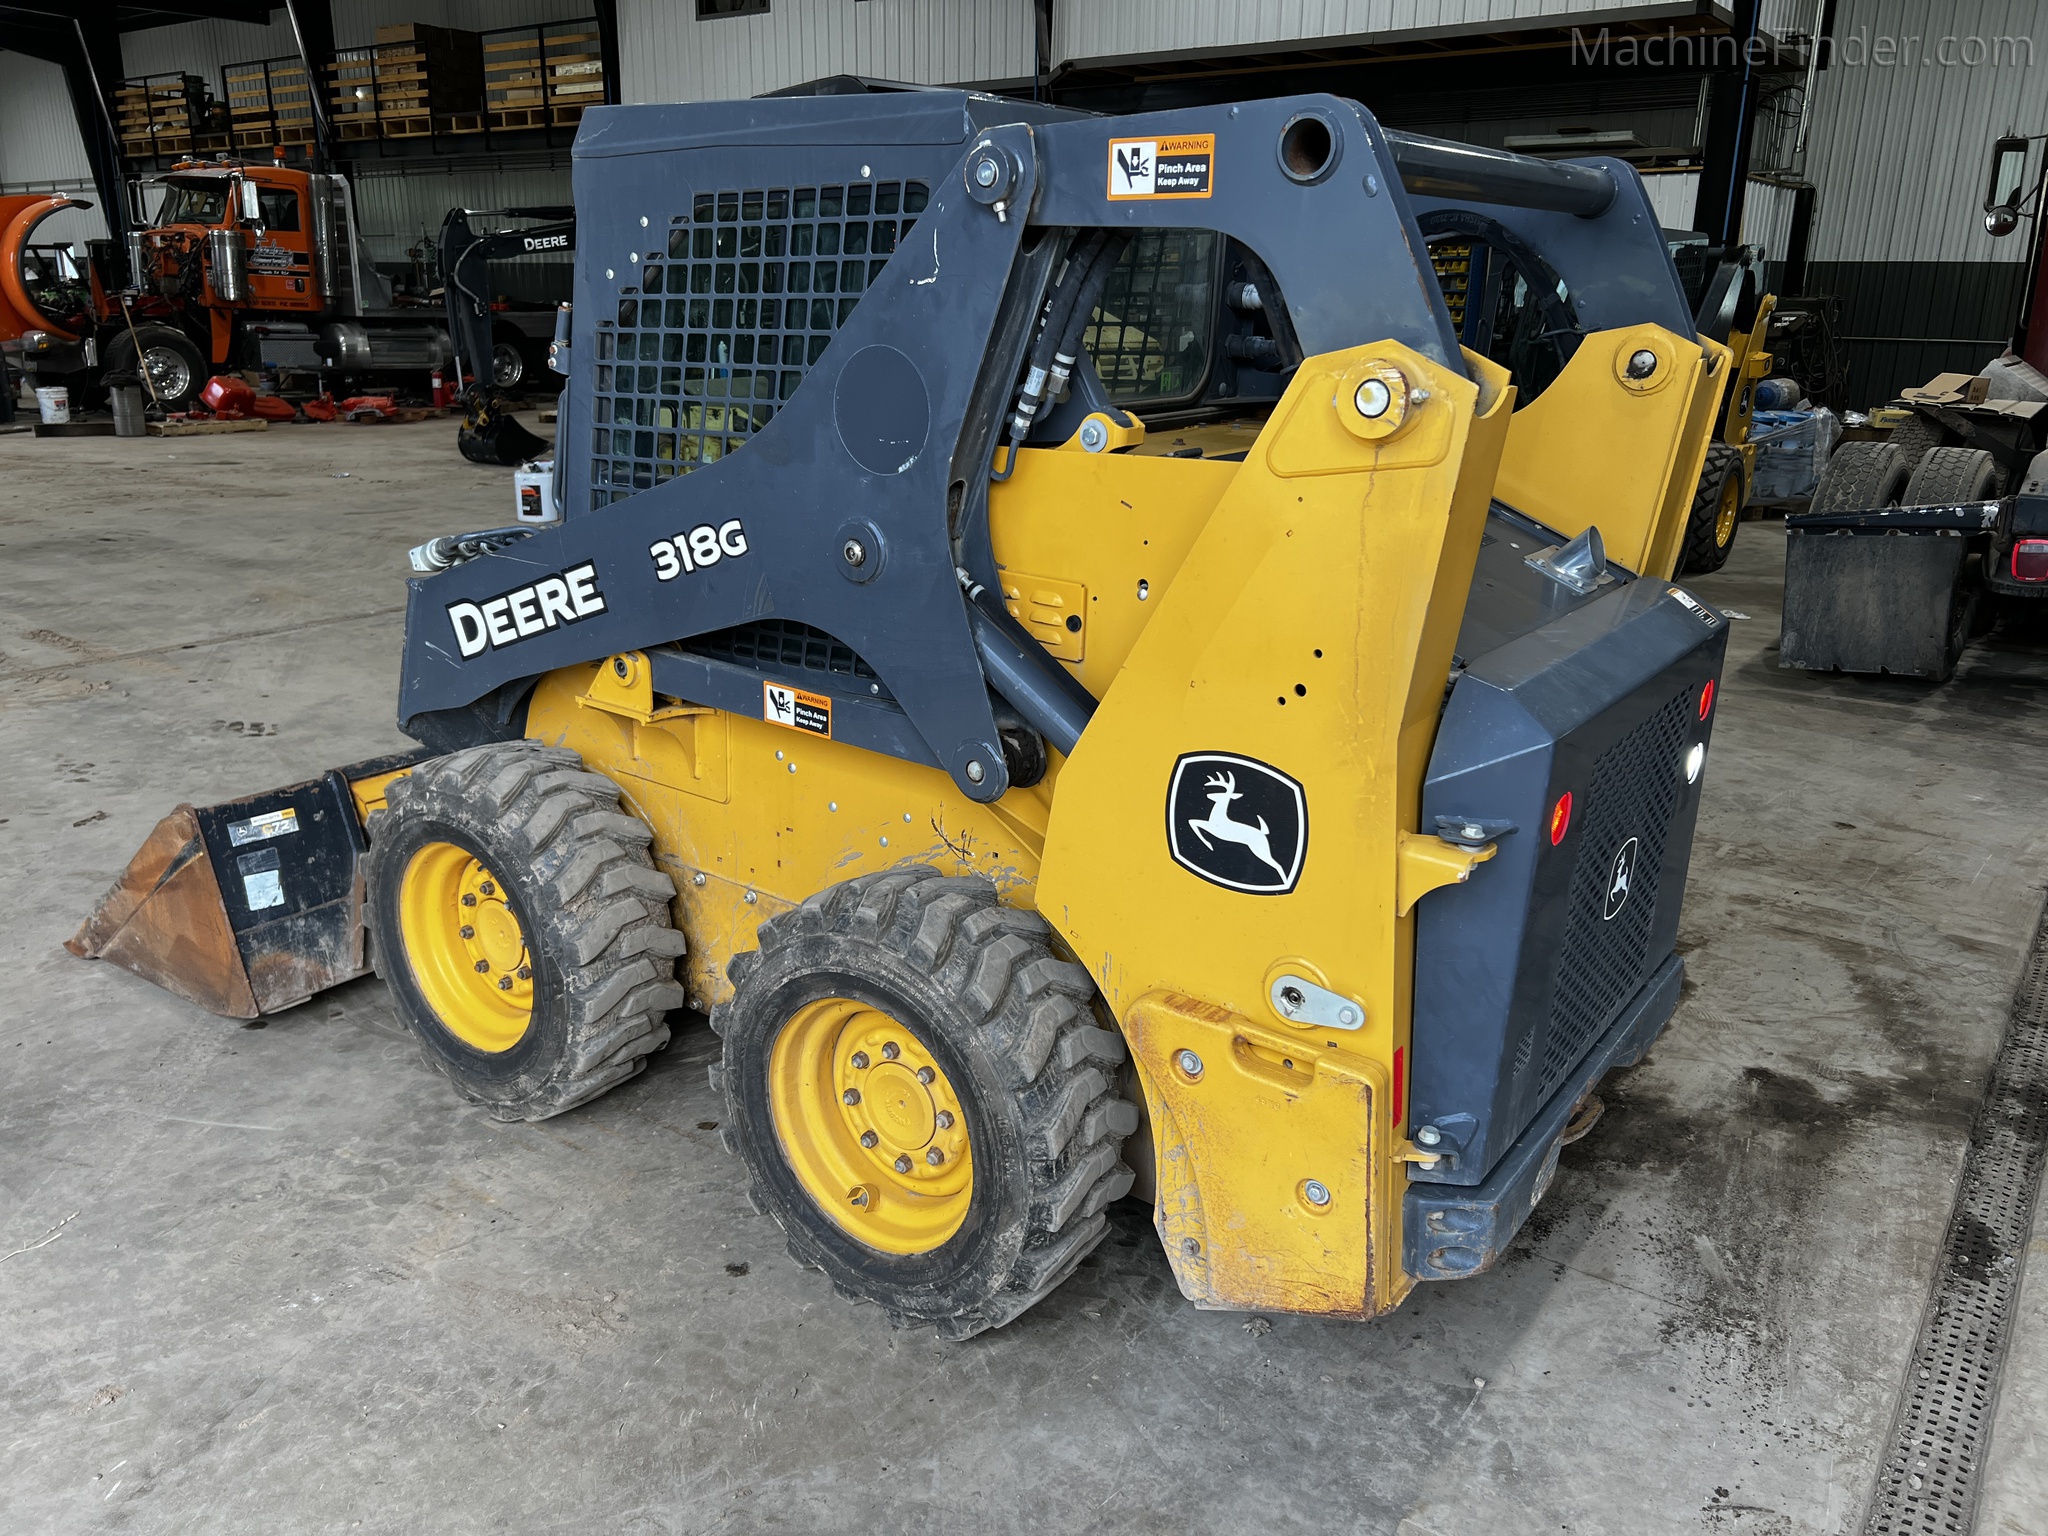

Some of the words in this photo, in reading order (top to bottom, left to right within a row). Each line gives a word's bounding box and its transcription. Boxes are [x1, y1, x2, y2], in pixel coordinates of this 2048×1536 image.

[1169, 141, 1209, 150] WARNING
[1158, 163, 1183, 173] Pinch
[1185, 162, 1206, 173] Area
[1157, 177, 1177, 187] Keep
[1178, 176, 1200, 186] Away
[524, 235, 568, 251] DEERE
[650, 519, 748, 581] 318G
[448, 563, 605, 657] DEERE
[801, 694, 828, 707] WARNING
[796, 707, 812, 718] Pinch
[813, 711, 827, 722] Area
[796, 716, 809, 725] Keep
[809, 720, 823, 729] Away
